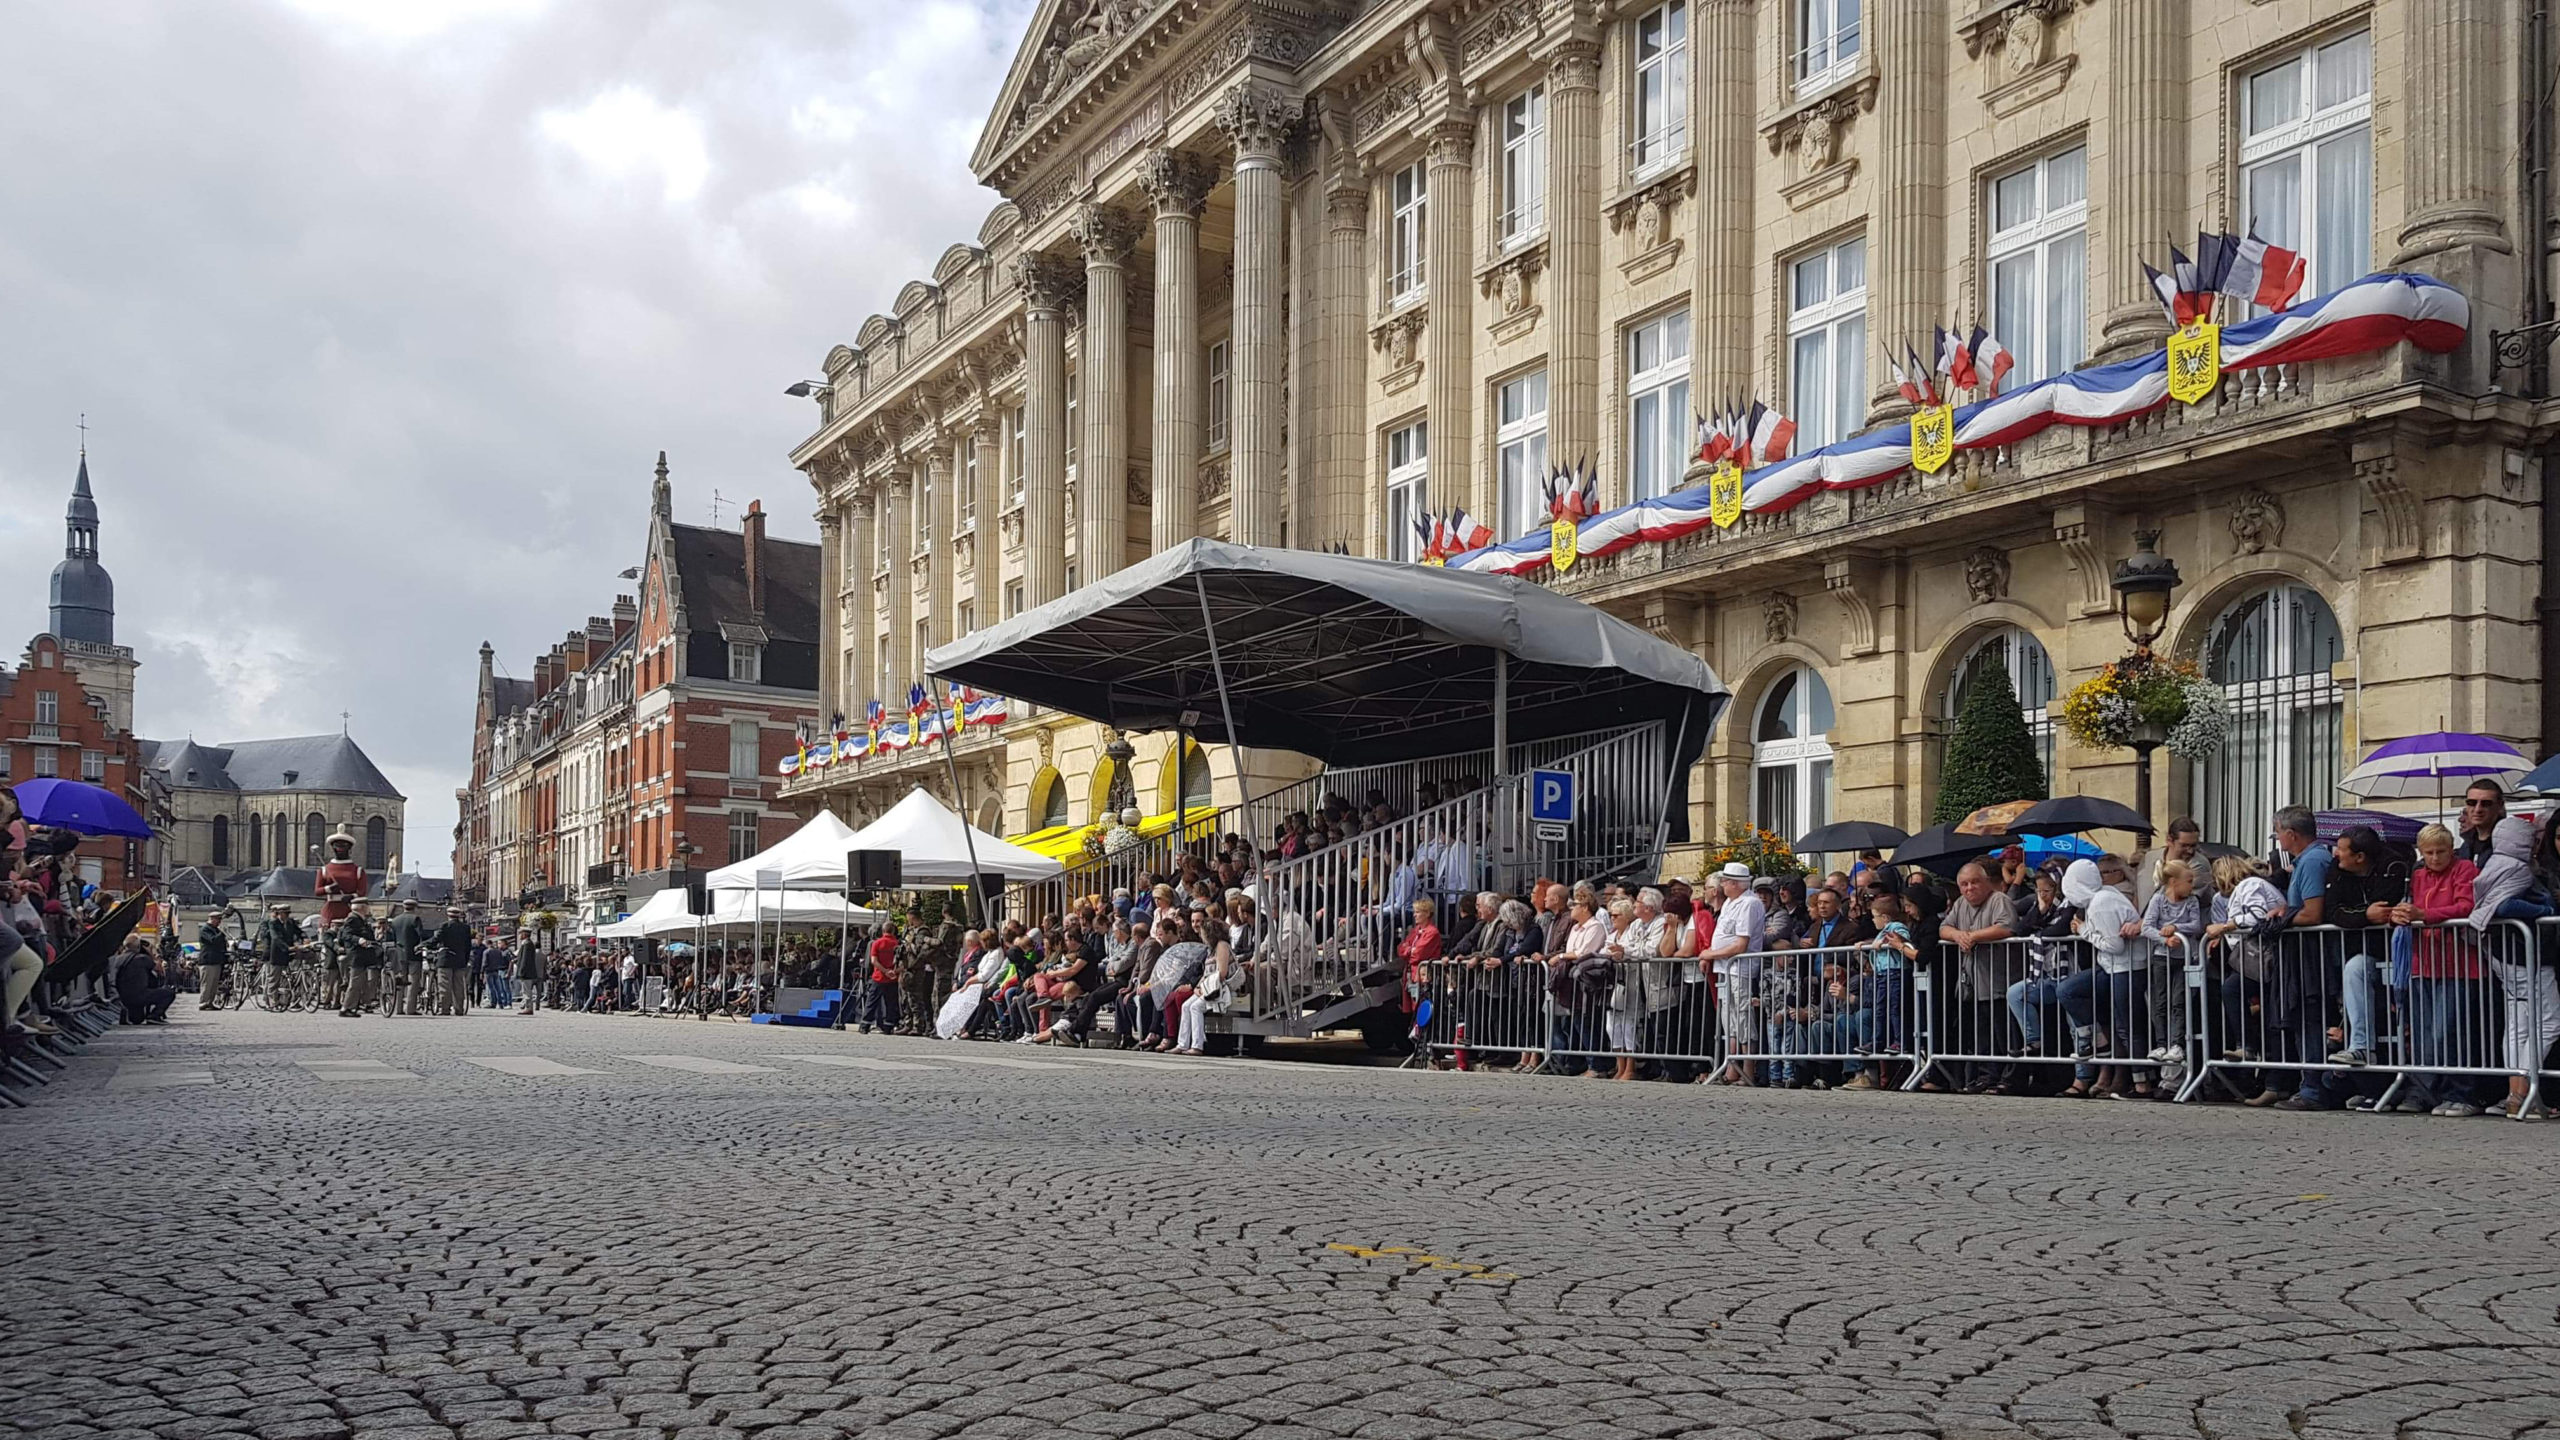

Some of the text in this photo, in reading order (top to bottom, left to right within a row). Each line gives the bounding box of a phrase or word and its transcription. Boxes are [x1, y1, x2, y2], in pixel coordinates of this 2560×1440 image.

[1118, 131, 1128, 151] DE
[1130, 101, 1159, 139] VILLE
[1543, 780, 1562, 811] P
